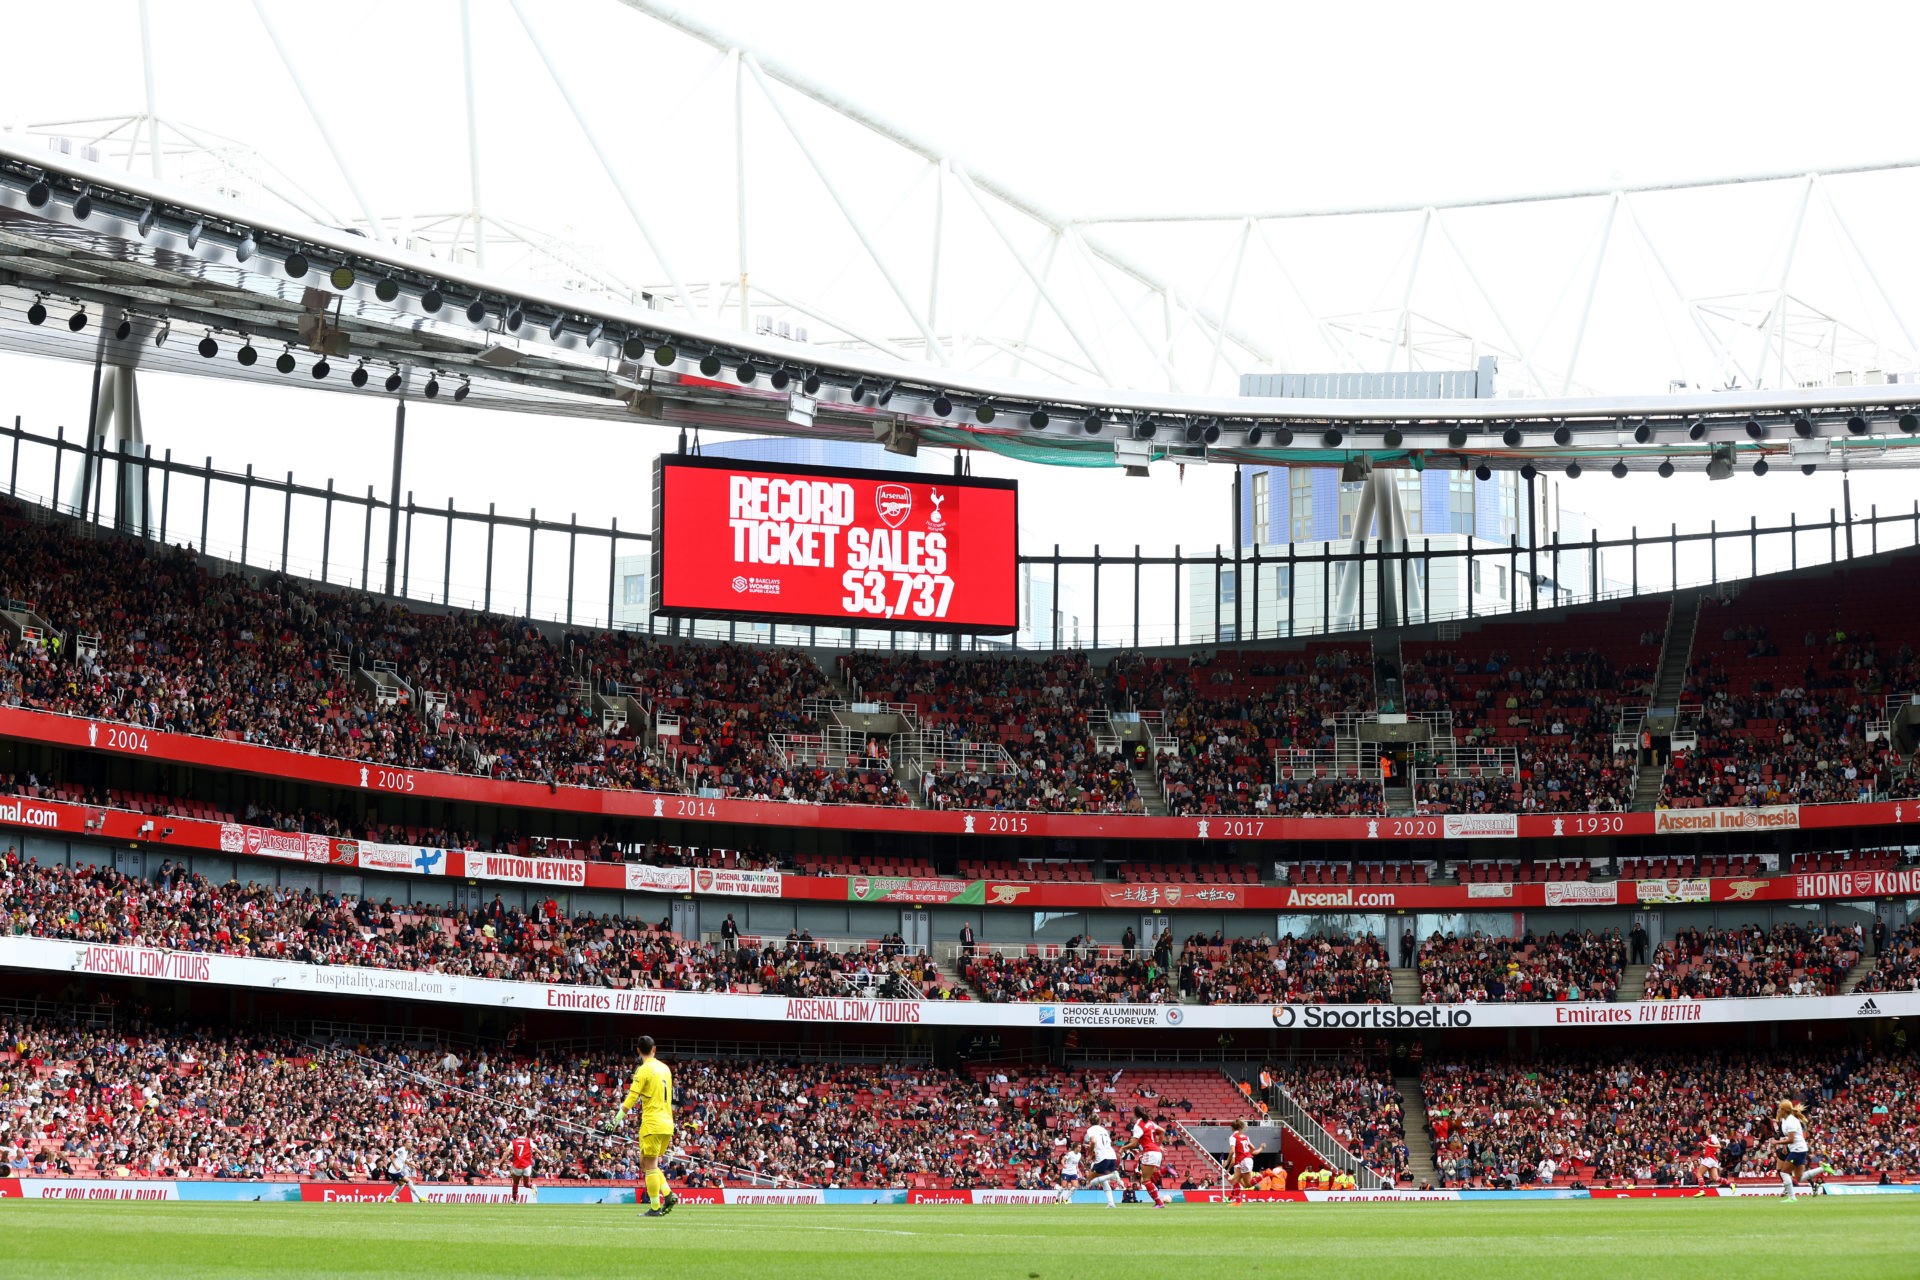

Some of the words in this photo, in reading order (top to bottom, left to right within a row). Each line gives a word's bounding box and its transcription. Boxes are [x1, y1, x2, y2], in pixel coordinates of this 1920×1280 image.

[730, 475, 855, 526] RECORD
[881, 491, 907, 500] Arsenal
[729, 519, 840, 569] TICKET
[847, 528, 947, 576] SALES
[749, 583, 781, 591] WOMEN'S
[842, 570, 955, 619] 53,737
[108, 728, 148, 751] 2004
[378, 770, 414, 792] 2005
[677, 800, 715, 817] 2014
[989, 817, 1028, 833] 2015
[1223, 821, 1264, 836] 2017
[1393, 821, 1437, 836] 2020
[1462, 816, 1515, 832] Arsenal
[1575, 817, 1623, 833] 1930
[1657, 811, 1717, 831] Arsenal
[260, 829, 306, 853] Arsenal
[486, 856, 534, 880] MILTON
[536, 860, 584, 883] KEYNES
[715, 872, 740, 881] ARSENAL
[716, 882, 735, 892] WITH
[736, 882, 750, 893] YOU
[751, 884, 779, 894] ALWAYS
[874, 879, 911, 891] ARSENAL
[911, 880, 966, 893] BANGLADESH
[1563, 883, 1617, 898] Arsenal
[1638, 884, 1664, 893] ARSENAL
[1681, 883, 1708, 892] JAMAICA
[1803, 873, 1852, 897] HONG
[1874, 871, 1920, 894] KONG
[1287, 889, 1395, 907] Arsenal.com
[84, 947, 210, 981] ARSENAL.COM/TOURS
[315, 968, 443, 994] hospitality.arsenal.com
[547, 989, 610, 1010] Emirates
[615, 993, 632, 1011] FLY
[633, 994, 666, 1013] BETTER
[786, 999, 920, 1023] ARSENAL.COM/TOURS
[1062, 1007, 1101, 1017] CHOOSE
[1102, 1007, 1159, 1016] ALUMINIUM.
[1303, 1006, 1472, 1028] Sportsbet.io
[1555, 1007, 1632, 1024] Emirates
[1639, 1005, 1659, 1022] FLY
[1661, 1004, 1701, 1021] BETTER
[1063, 1016, 1110, 1025] RECYCLES
[1112, 1016, 1158, 1025] FOREVER.
[661, 1080, 668, 1101] 1
[517, 1144, 525, 1157] 7
